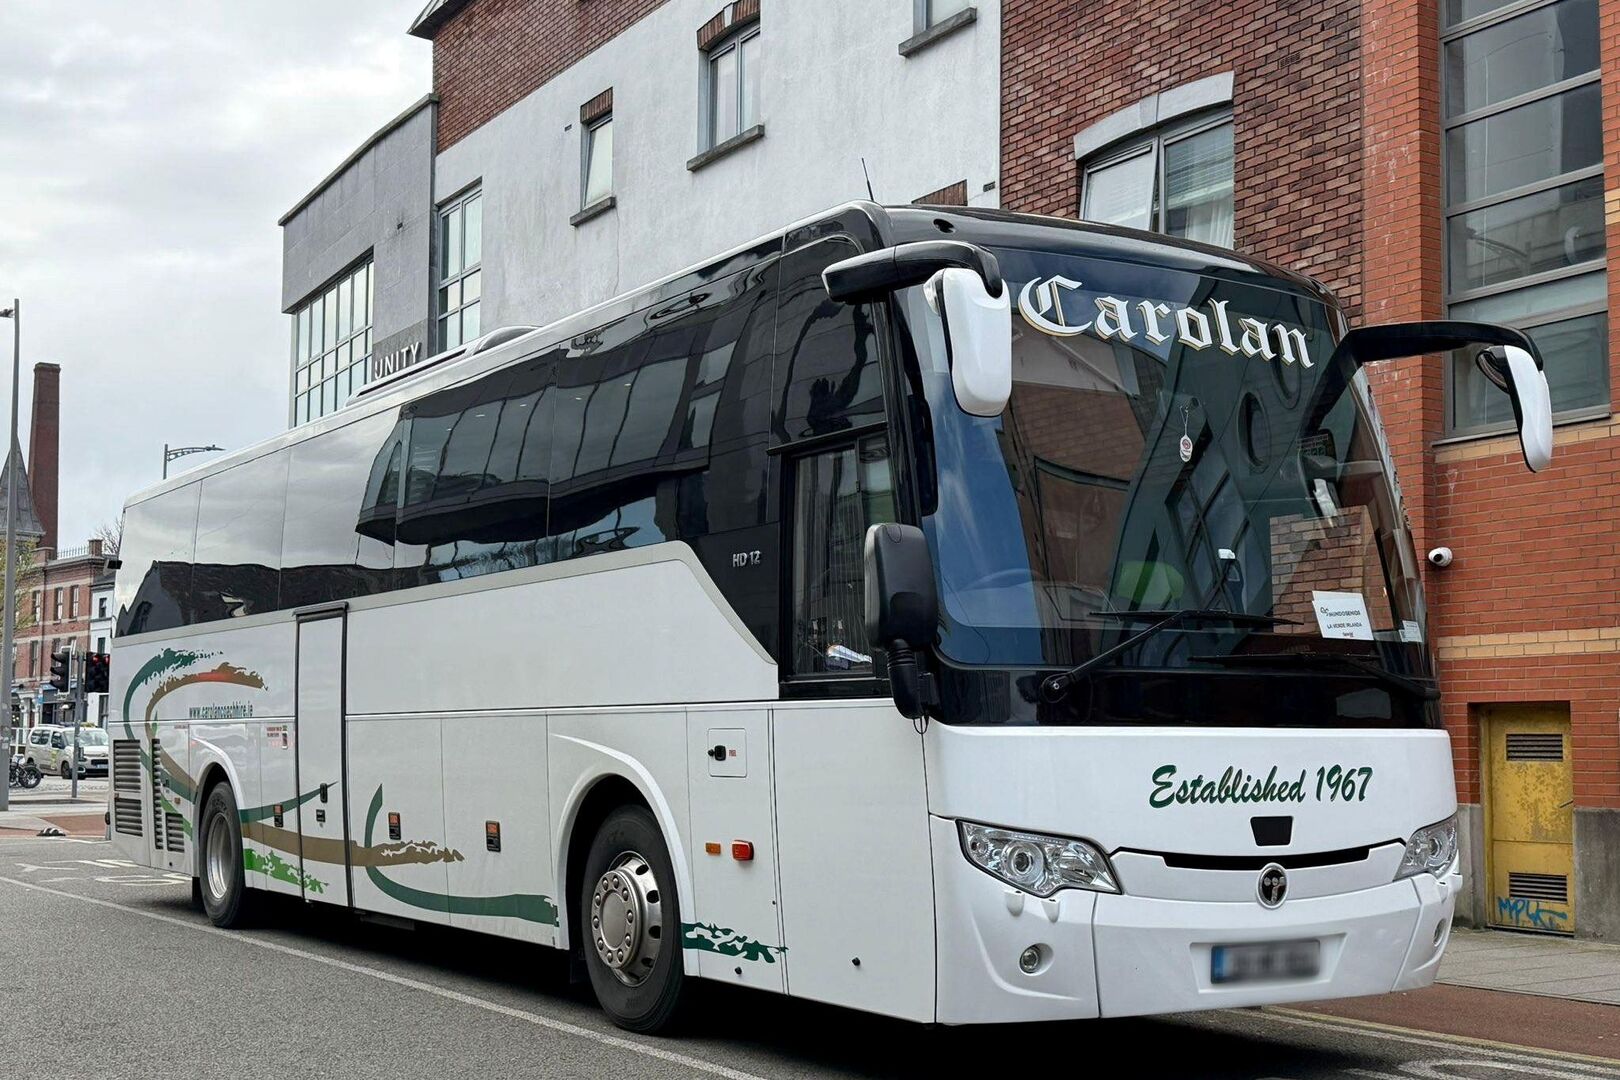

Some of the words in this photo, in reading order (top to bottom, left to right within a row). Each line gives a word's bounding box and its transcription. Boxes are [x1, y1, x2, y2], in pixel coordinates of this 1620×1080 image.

[1018, 274, 1314, 369] Carolan
[374, 341, 419, 380] UNITY
[1149, 764, 1307, 809] Established
[1316, 764, 1373, 802] 1967
